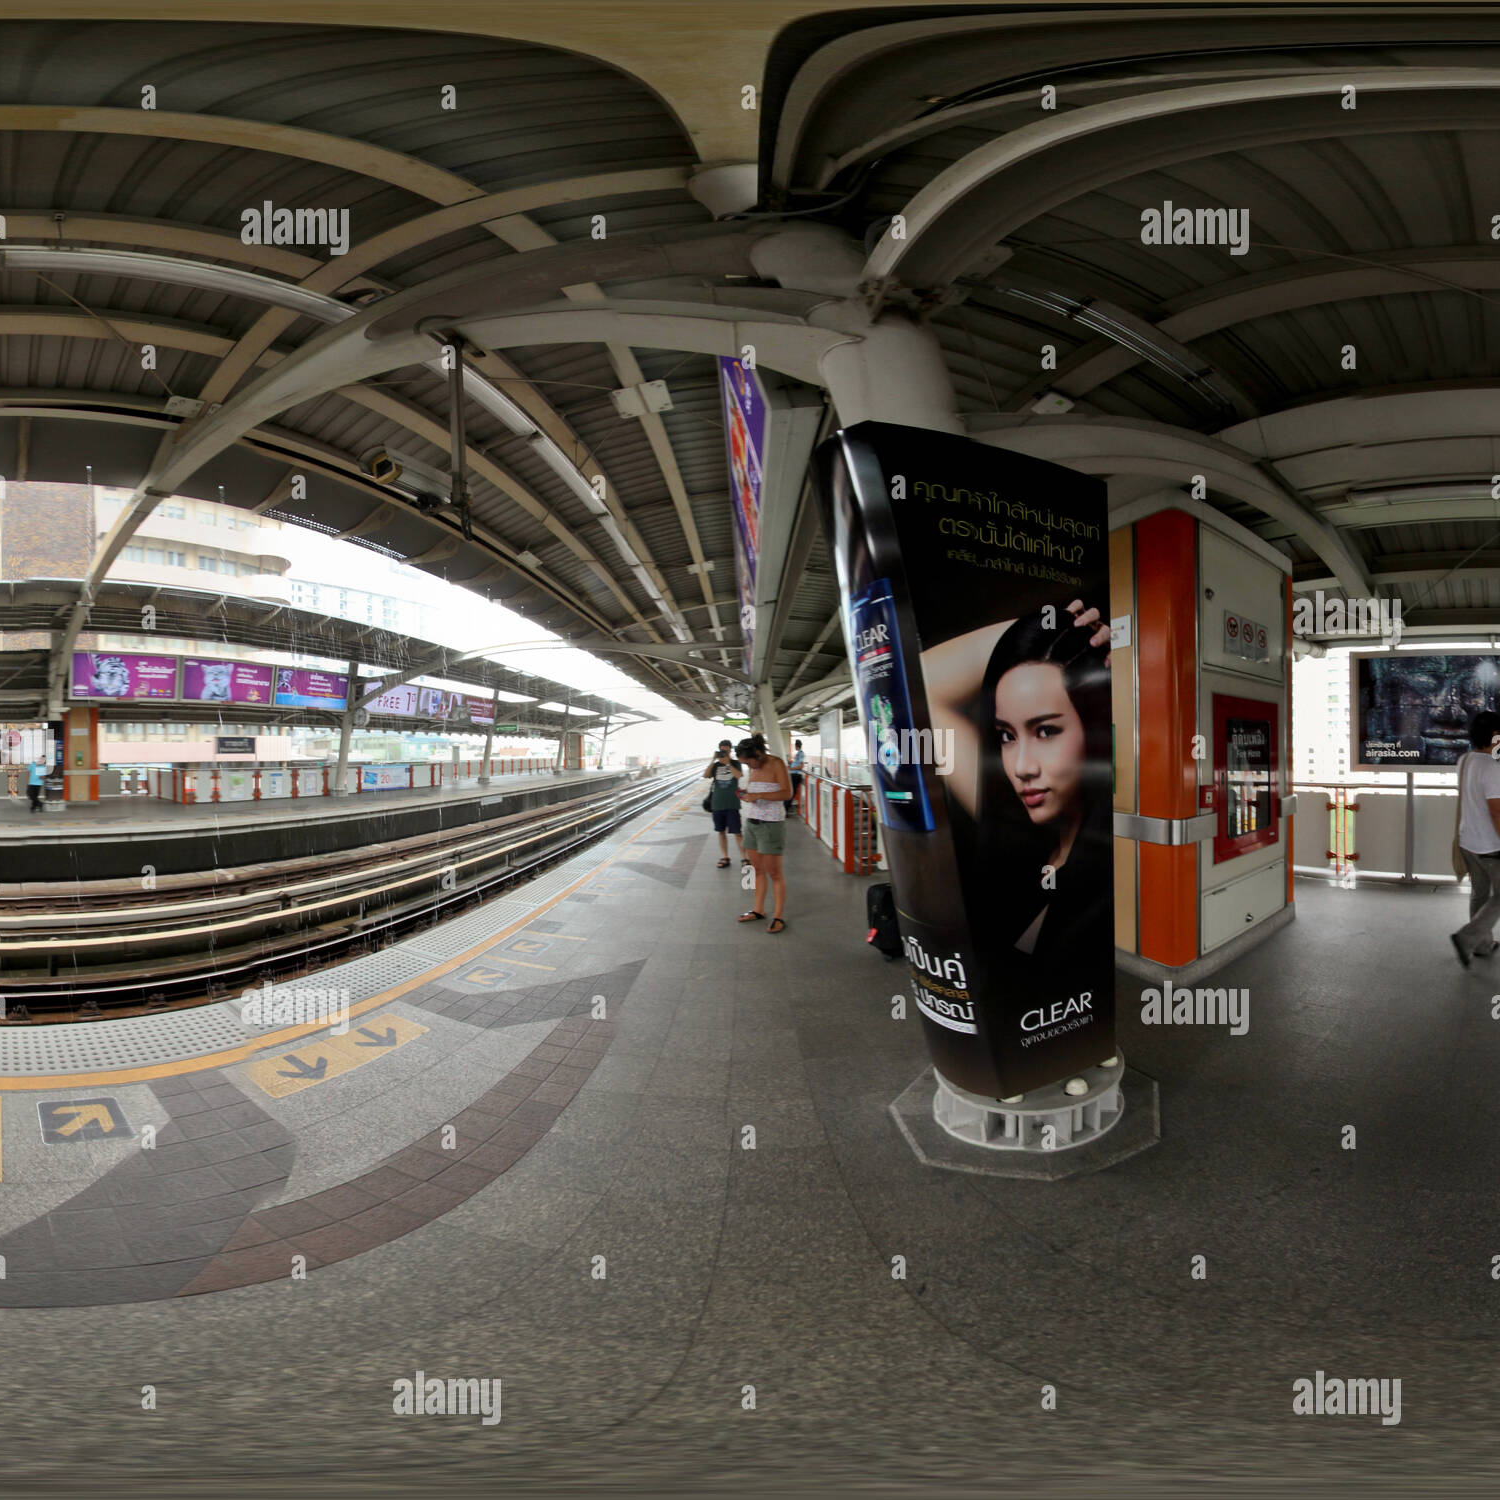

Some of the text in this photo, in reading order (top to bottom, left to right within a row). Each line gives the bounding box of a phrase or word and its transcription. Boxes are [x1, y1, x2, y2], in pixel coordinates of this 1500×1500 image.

[377, 694, 401, 710] FREE
[1365, 749, 1420, 758] airasia.com
[1020, 991, 1093, 1032] CLEAR
